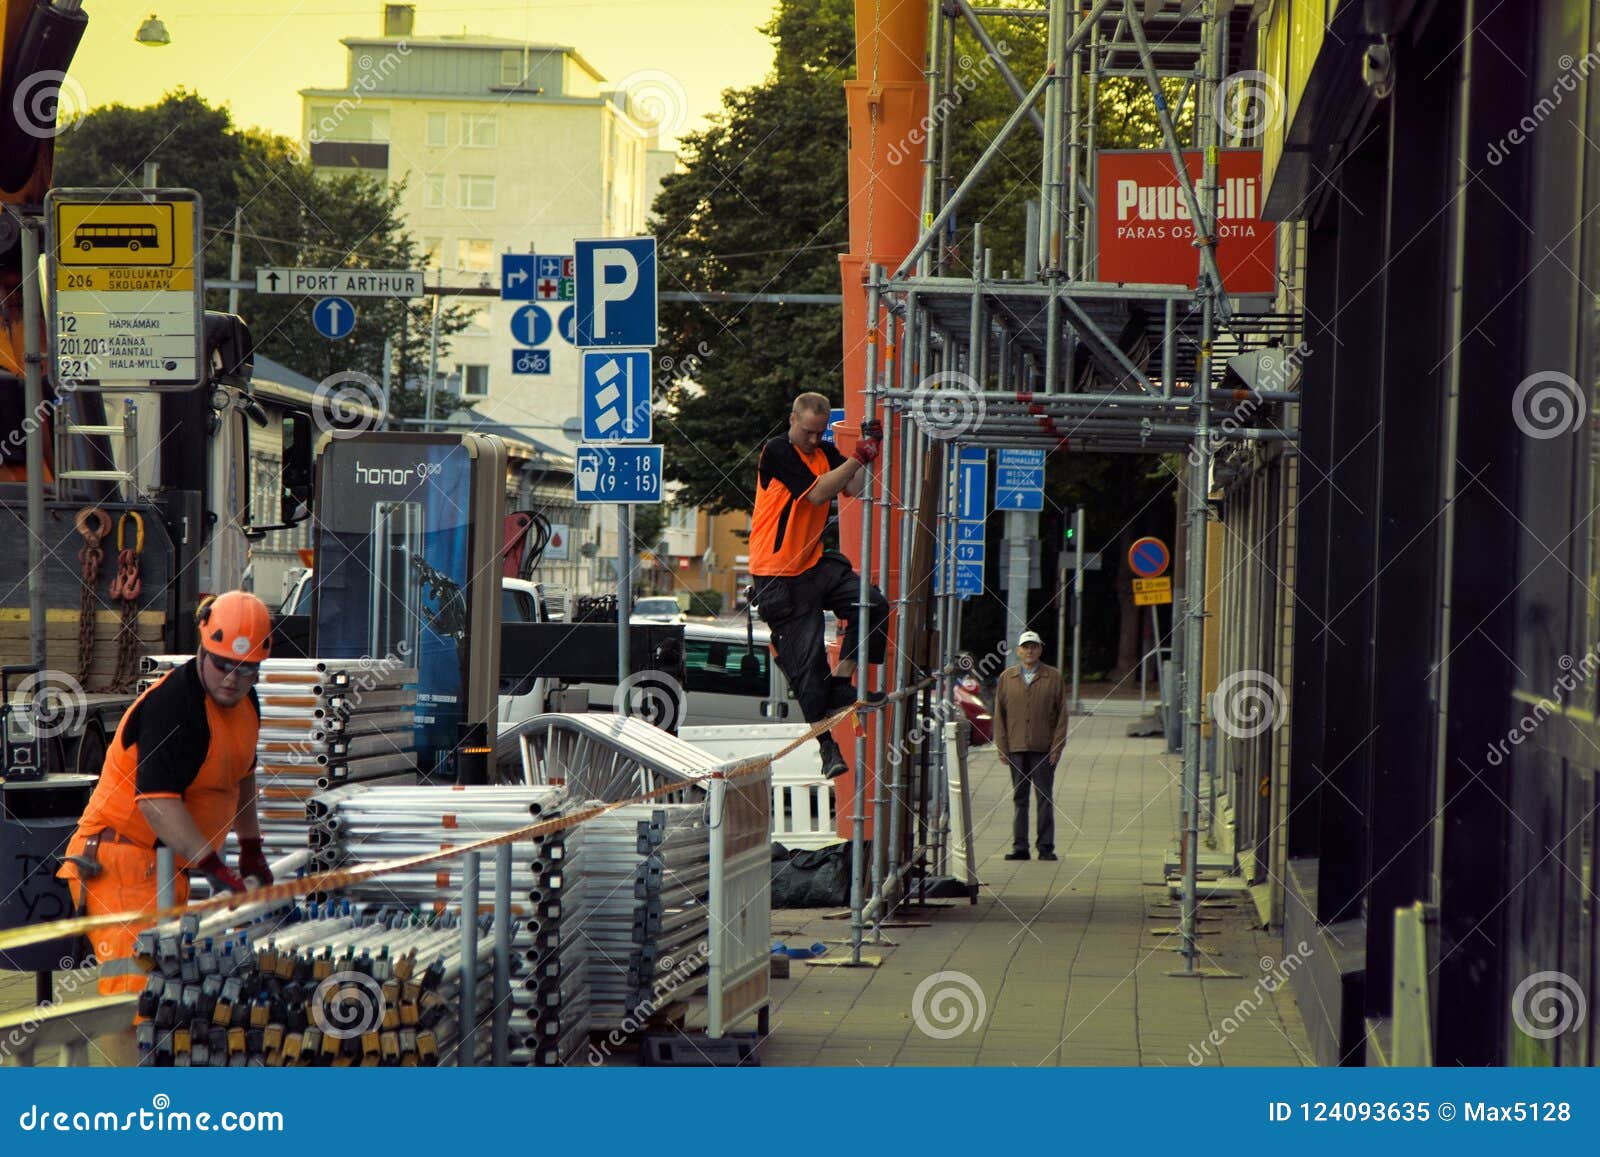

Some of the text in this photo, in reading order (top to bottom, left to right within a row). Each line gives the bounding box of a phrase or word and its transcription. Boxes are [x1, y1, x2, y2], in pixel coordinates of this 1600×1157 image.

[1117, 226, 1165, 239] PARAS
[67, 274, 93, 288] 206
[108, 269, 173, 279] KOULUKATU
[108, 280, 171, 290] SKOLGATAN
[296, 275, 416, 292] PORT ARTHUR
[593, 248, 639, 339] P
[60, 316, 77, 333] 12
[61, 360, 89, 377] 221
[607, 456, 616, 472] 9
[635, 455, 651, 472] 18
[356, 460, 414, 485] honor
[961, 546, 974, 559] 19
